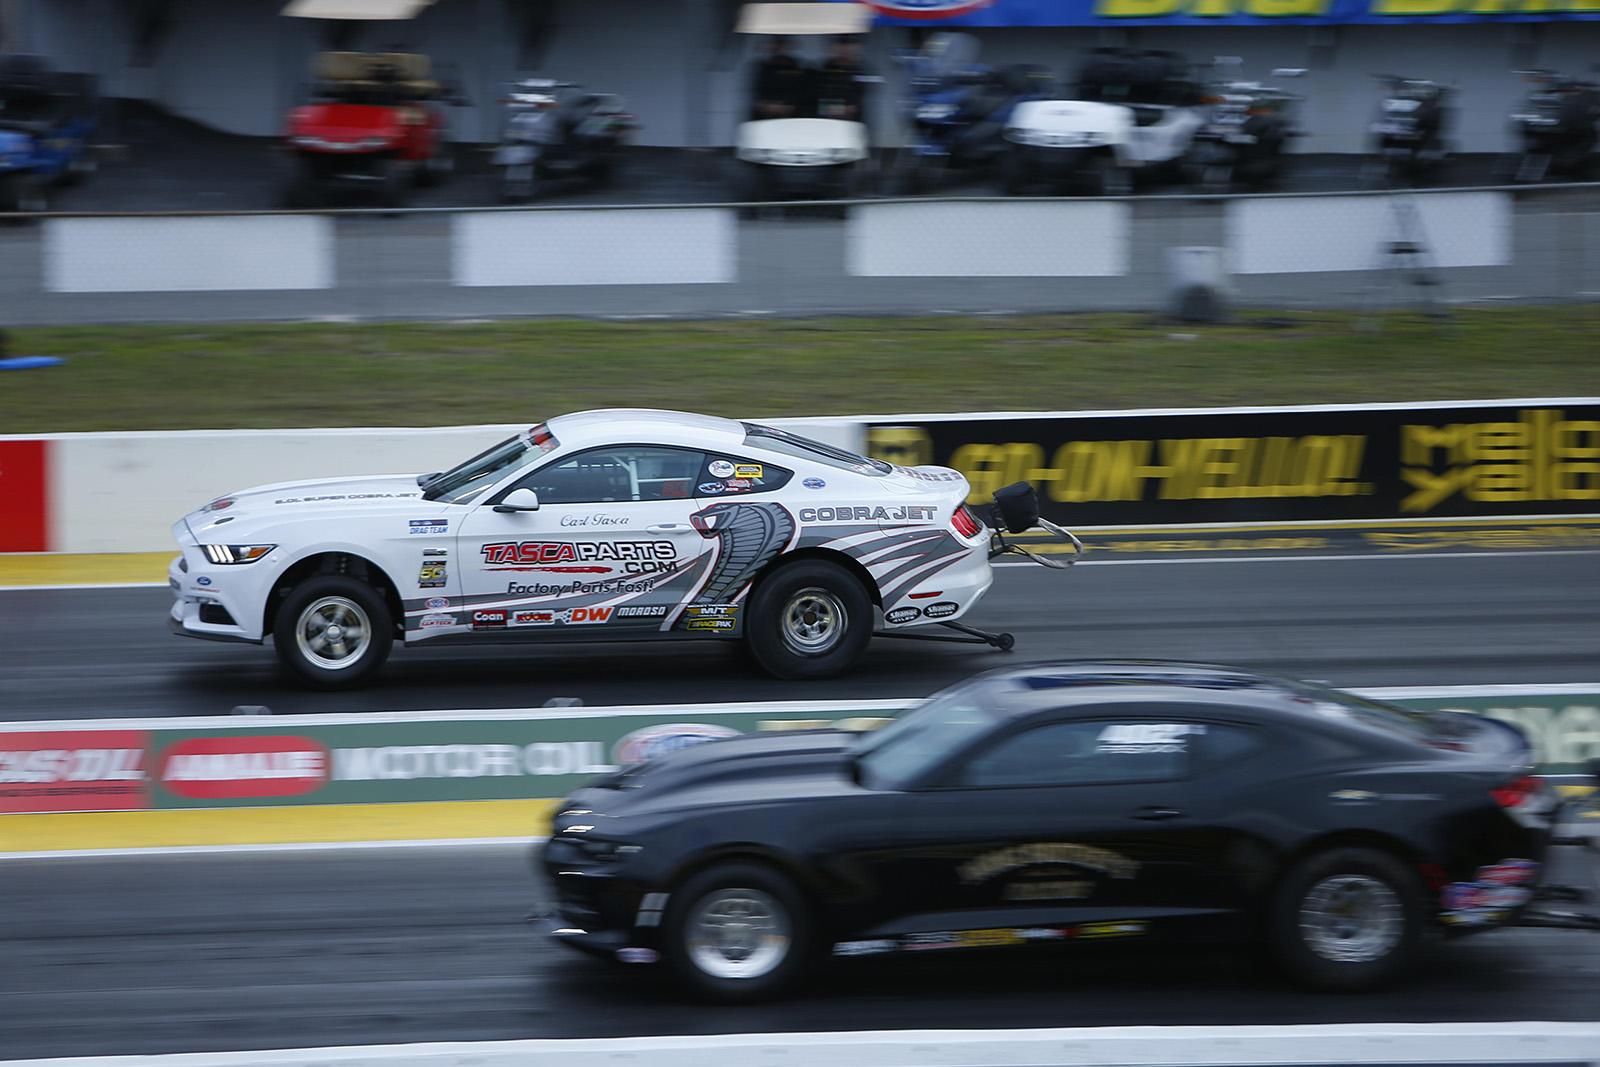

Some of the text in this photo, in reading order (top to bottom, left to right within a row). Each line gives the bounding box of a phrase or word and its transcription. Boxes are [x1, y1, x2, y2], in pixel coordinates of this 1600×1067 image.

[560, 513, 629, 527] Carl Tasca
[507, 579, 654, 597] Factory Parts Fast!
[473, 612, 504, 621] Coan
[571, 607, 612, 622] DW
[617, 606, 667, 617] MOROSO
[332, 744, 526, 780] MOTOR
[523, 741, 621, 775] OIL
